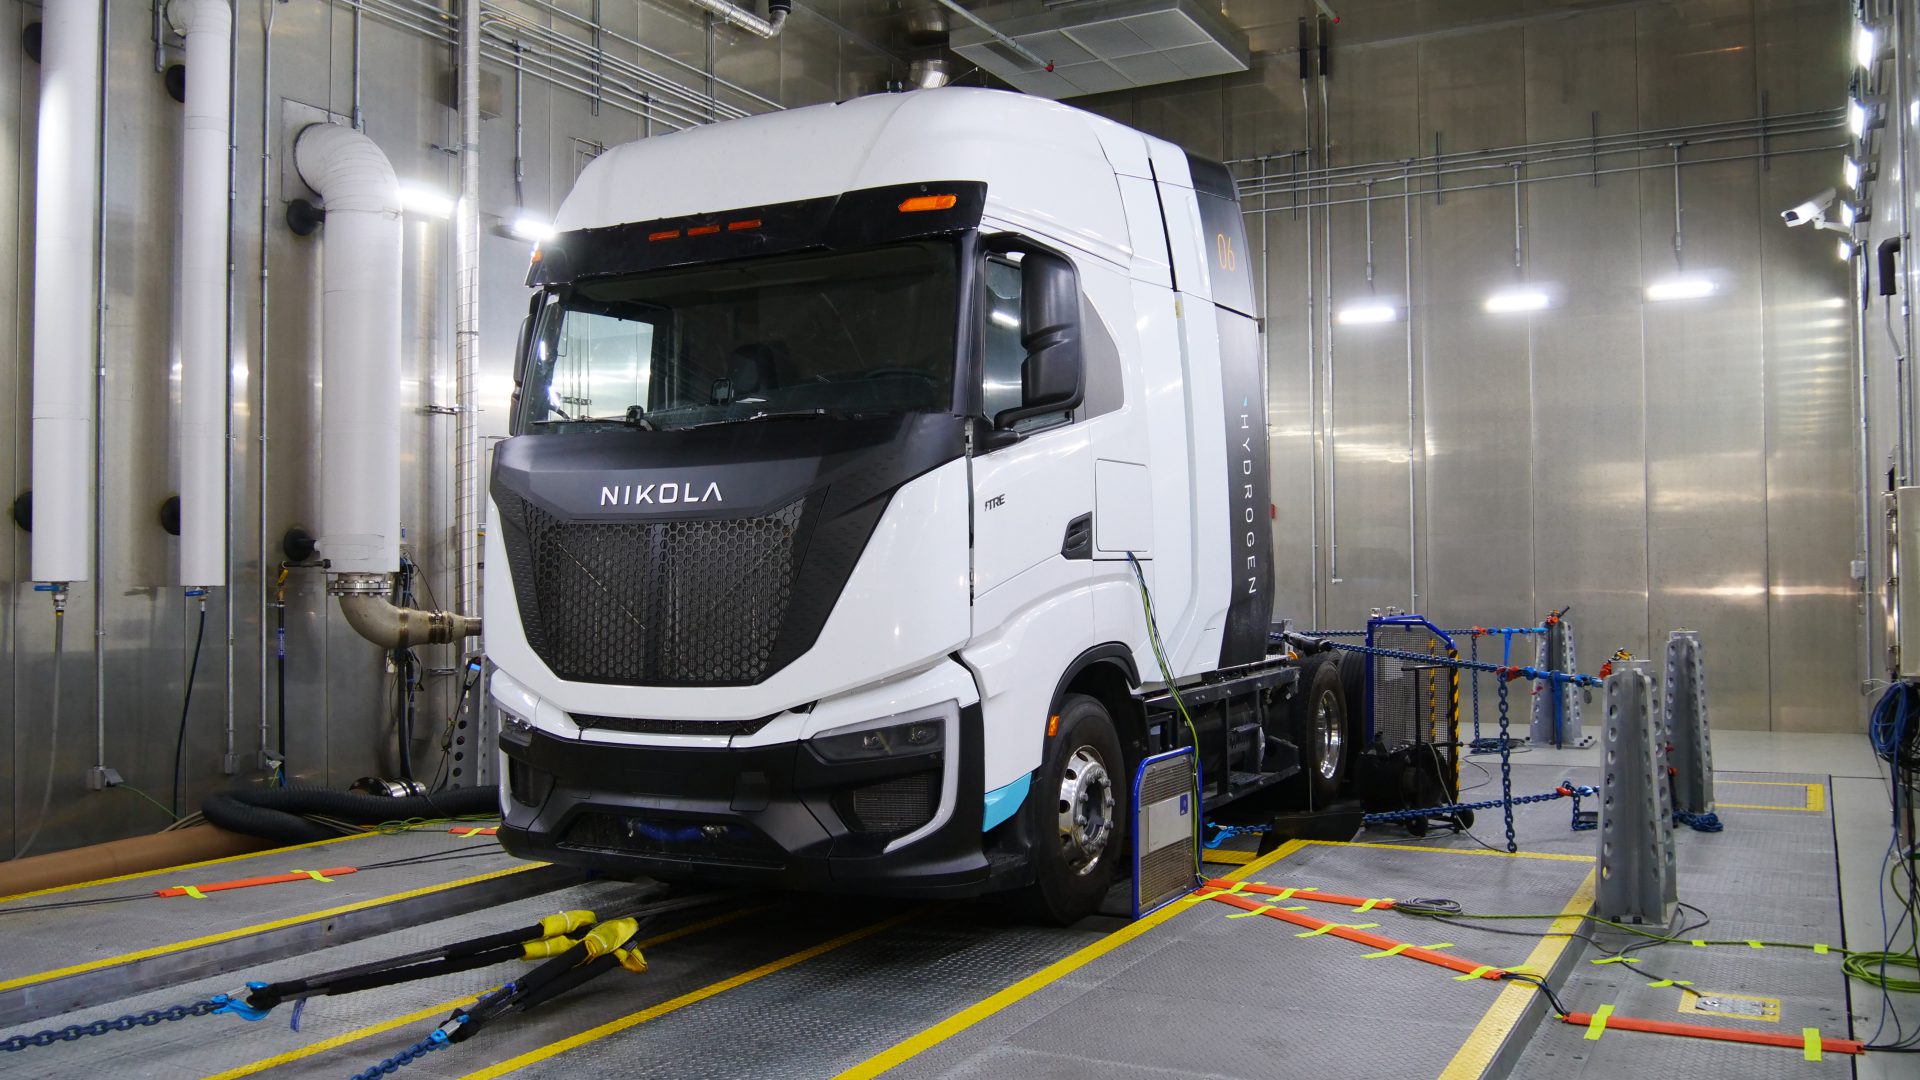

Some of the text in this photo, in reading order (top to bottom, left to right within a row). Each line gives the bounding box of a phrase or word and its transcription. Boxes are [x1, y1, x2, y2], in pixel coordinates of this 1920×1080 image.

[1217, 233, 1235, 272] 06
[600, 481, 723, 506] NIKOLA
[1240, 414, 1257, 594] HYDROGEN
